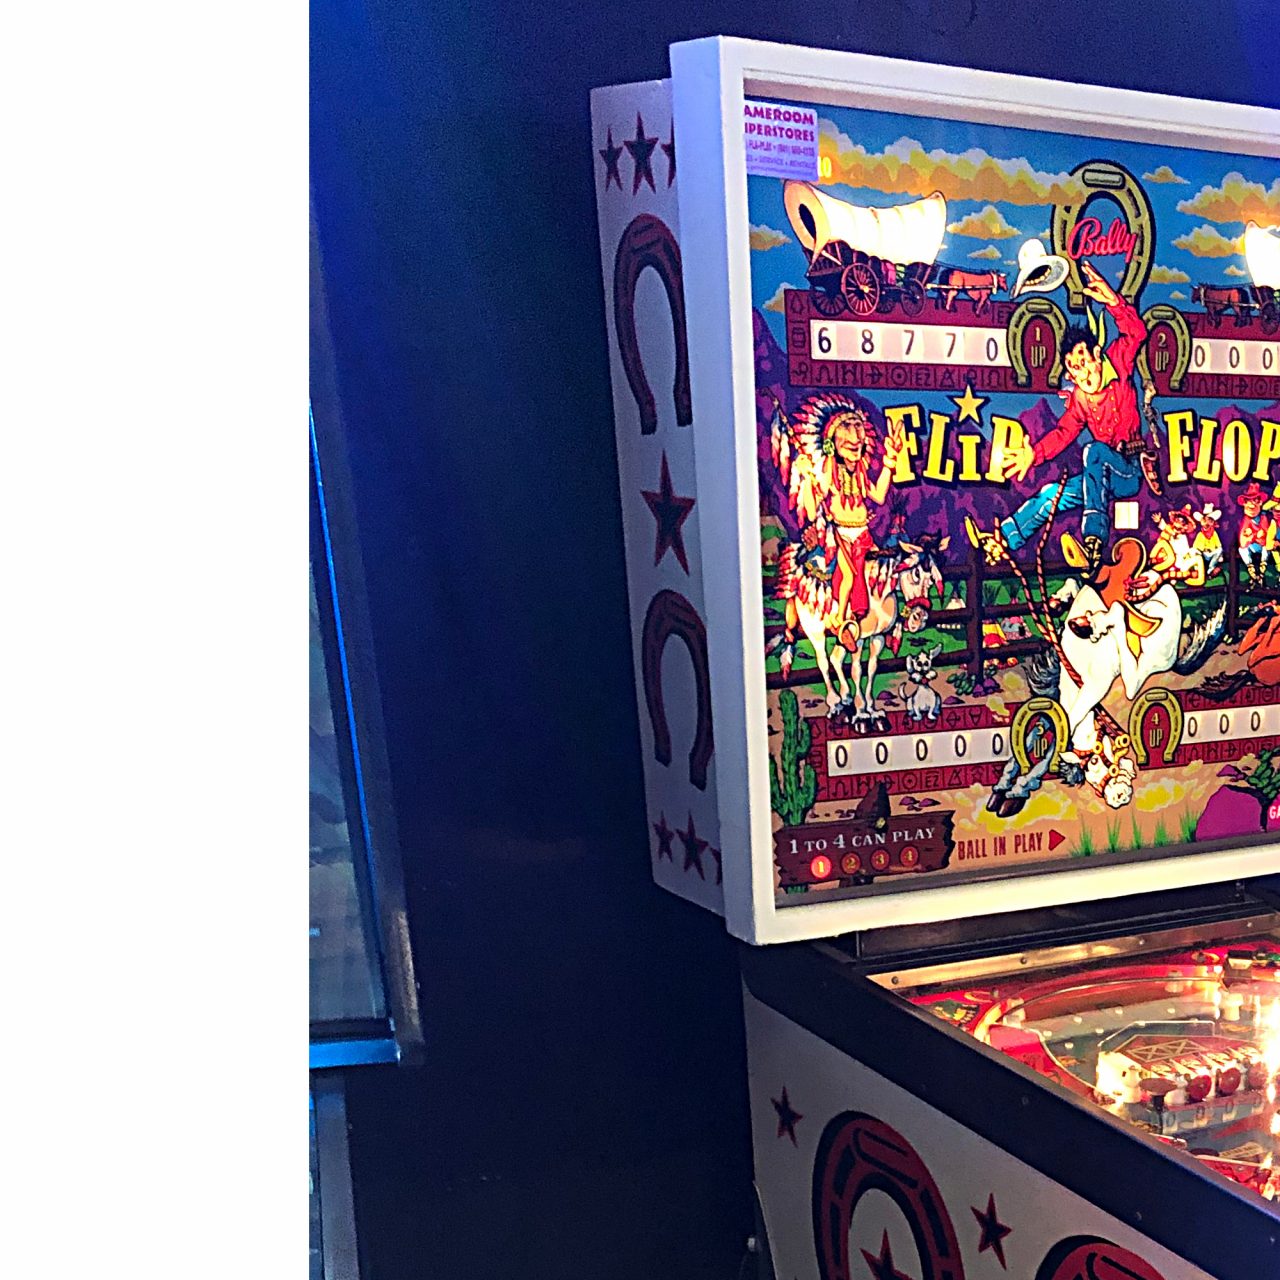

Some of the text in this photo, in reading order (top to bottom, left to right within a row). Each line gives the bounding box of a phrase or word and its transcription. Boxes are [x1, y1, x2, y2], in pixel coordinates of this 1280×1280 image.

[1066, 217, 1137, 264] Bally
[1158, 333, 1166, 348] 2
[1031, 345, 1046, 368] UP
[1155, 350, 1169, 370] UP
[1151, 712, 1159, 725] 4
[1033, 737, 1048, 758] UP
[1149, 728, 1163, 748] UP
[790, 827, 936, 854] 1 TO 4 CAN PLAY
[958, 832, 1043, 860] BALL IN PLAY
